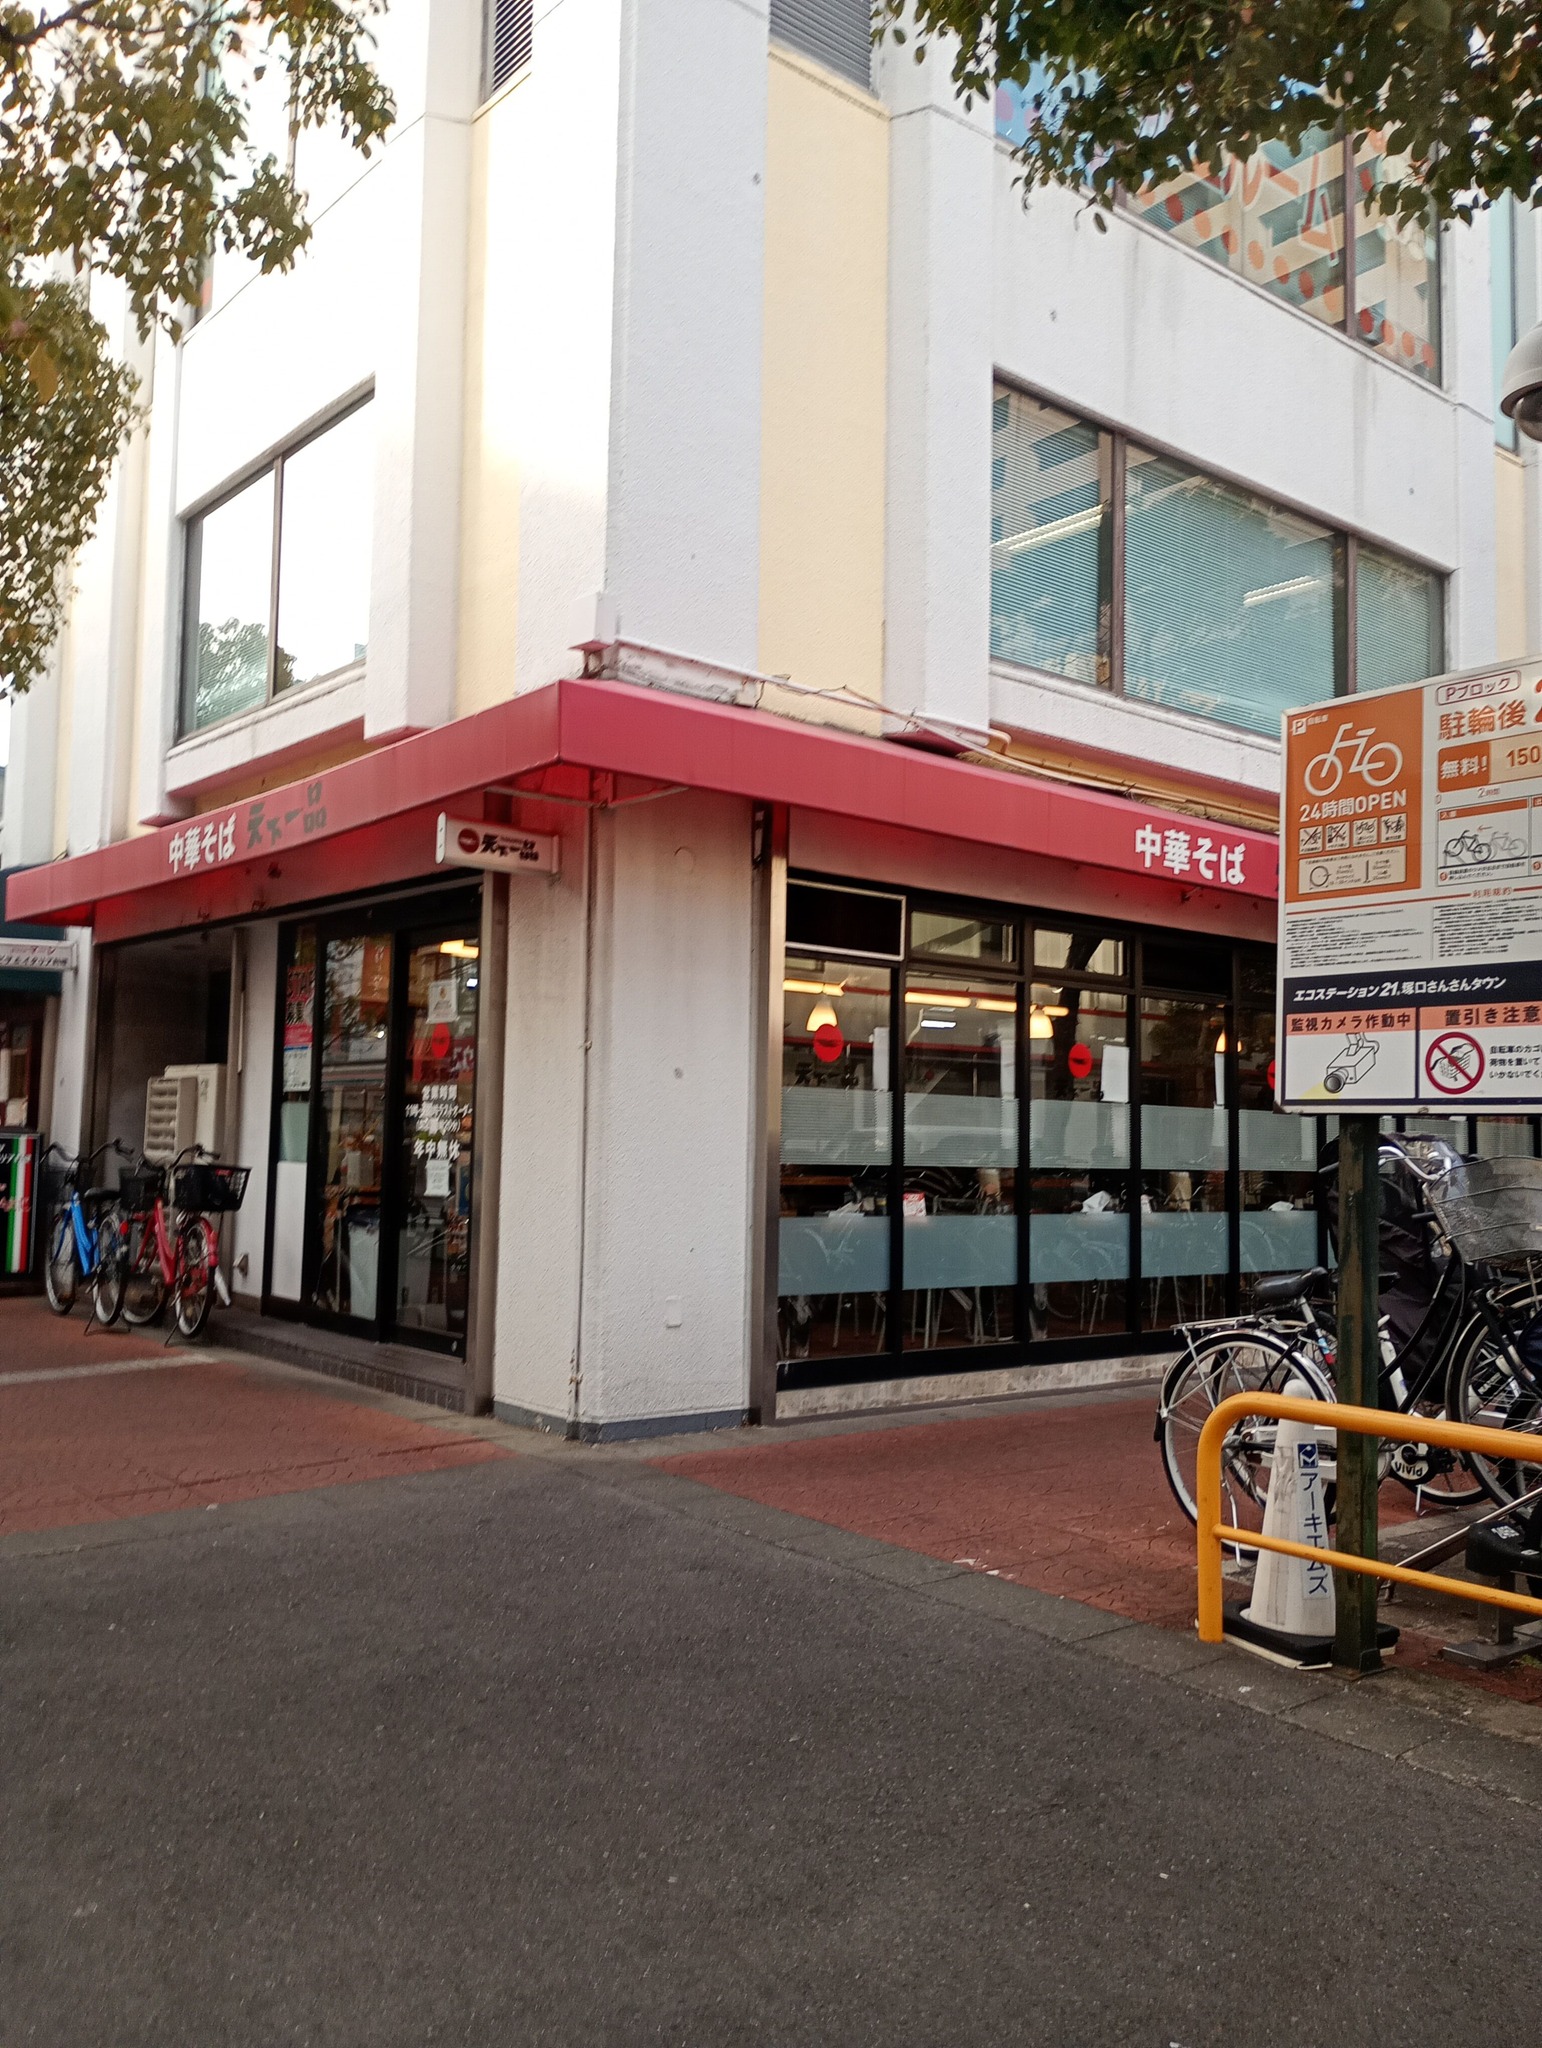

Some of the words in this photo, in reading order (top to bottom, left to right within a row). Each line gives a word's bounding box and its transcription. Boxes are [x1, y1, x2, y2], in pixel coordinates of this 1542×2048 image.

[1445, 678, 1511, 701] Pブロック
[1439, 700, 1527, 740] 駐輪後
[1300, 789, 1407, 823] 24時間OPEN
[169, 812, 237, 875] 中華そば
[1135, 823, 1247, 885] 中華そば
[1291, 1012, 1411, 1033] 監視カメラ作動中
[1445, 1005, 1541, 1027] 置引き注意
